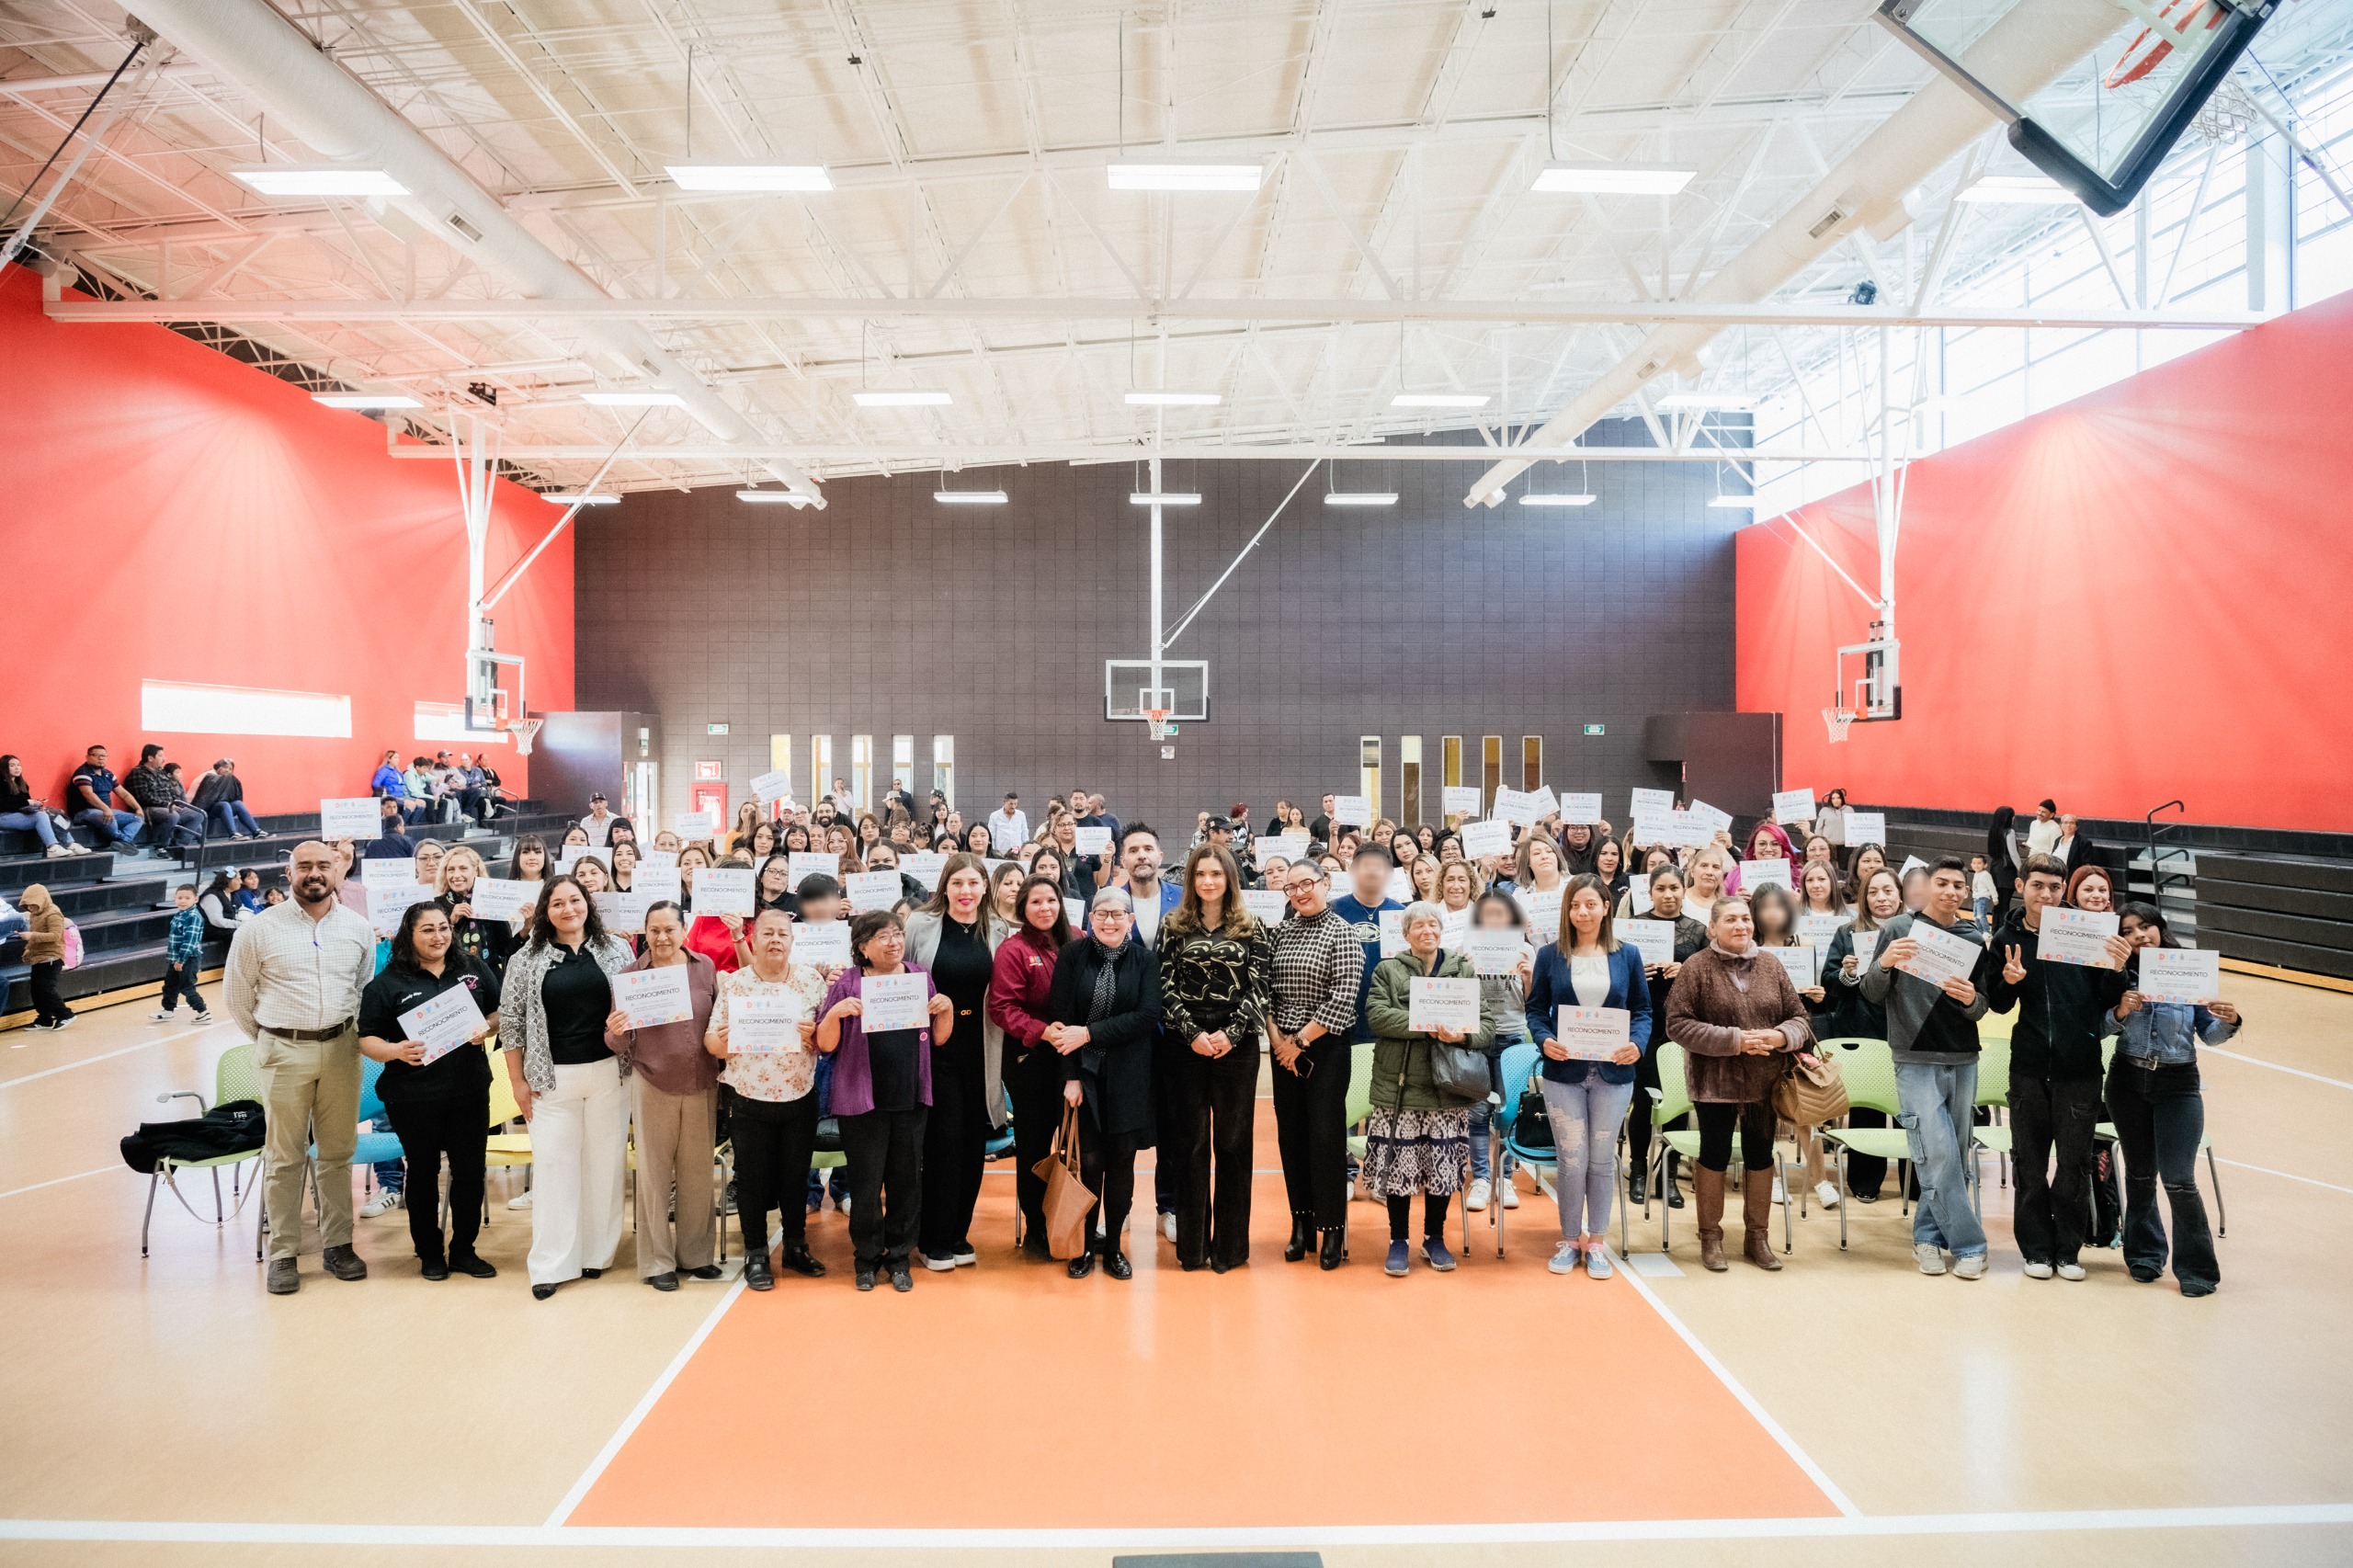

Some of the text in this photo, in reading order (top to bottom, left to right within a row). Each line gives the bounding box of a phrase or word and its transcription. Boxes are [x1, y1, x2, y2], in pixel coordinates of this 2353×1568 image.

[1500, 802, 1533, 812] RECONOCIMIENTO
[377, 905, 407, 915] RECONOCI
[2150, 969, 2208, 978] RECONOCIMIENTO
[625, 987, 680, 1002] RECONOCIMIENTO
[870, 994, 920, 1004] RECONOCIMIENTO
[417, 1006, 468, 1037] RECONOCIMIENTO
[1567, 1027, 1620, 1035] RECONOCIMIENTO
